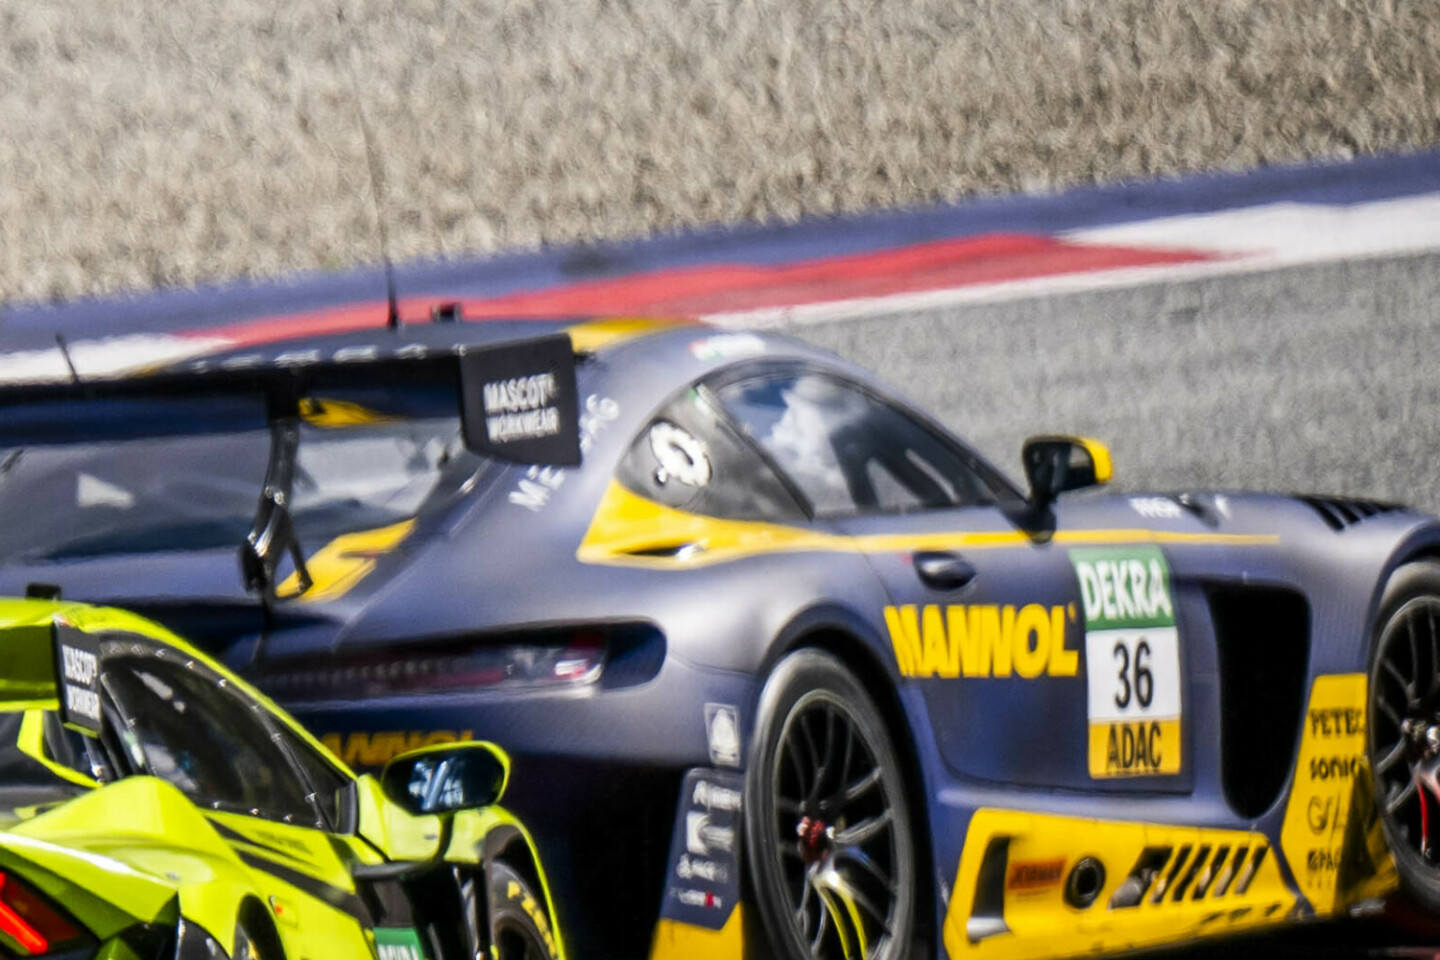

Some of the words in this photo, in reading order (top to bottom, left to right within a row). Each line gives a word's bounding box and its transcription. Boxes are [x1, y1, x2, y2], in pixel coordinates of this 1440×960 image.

[1077, 558, 1172, 622] DEKRA
[884, 603, 1079, 678] MANNOL
[1113, 640, 1155, 709] 36
[1107, 721, 1162, 769] ADAC
